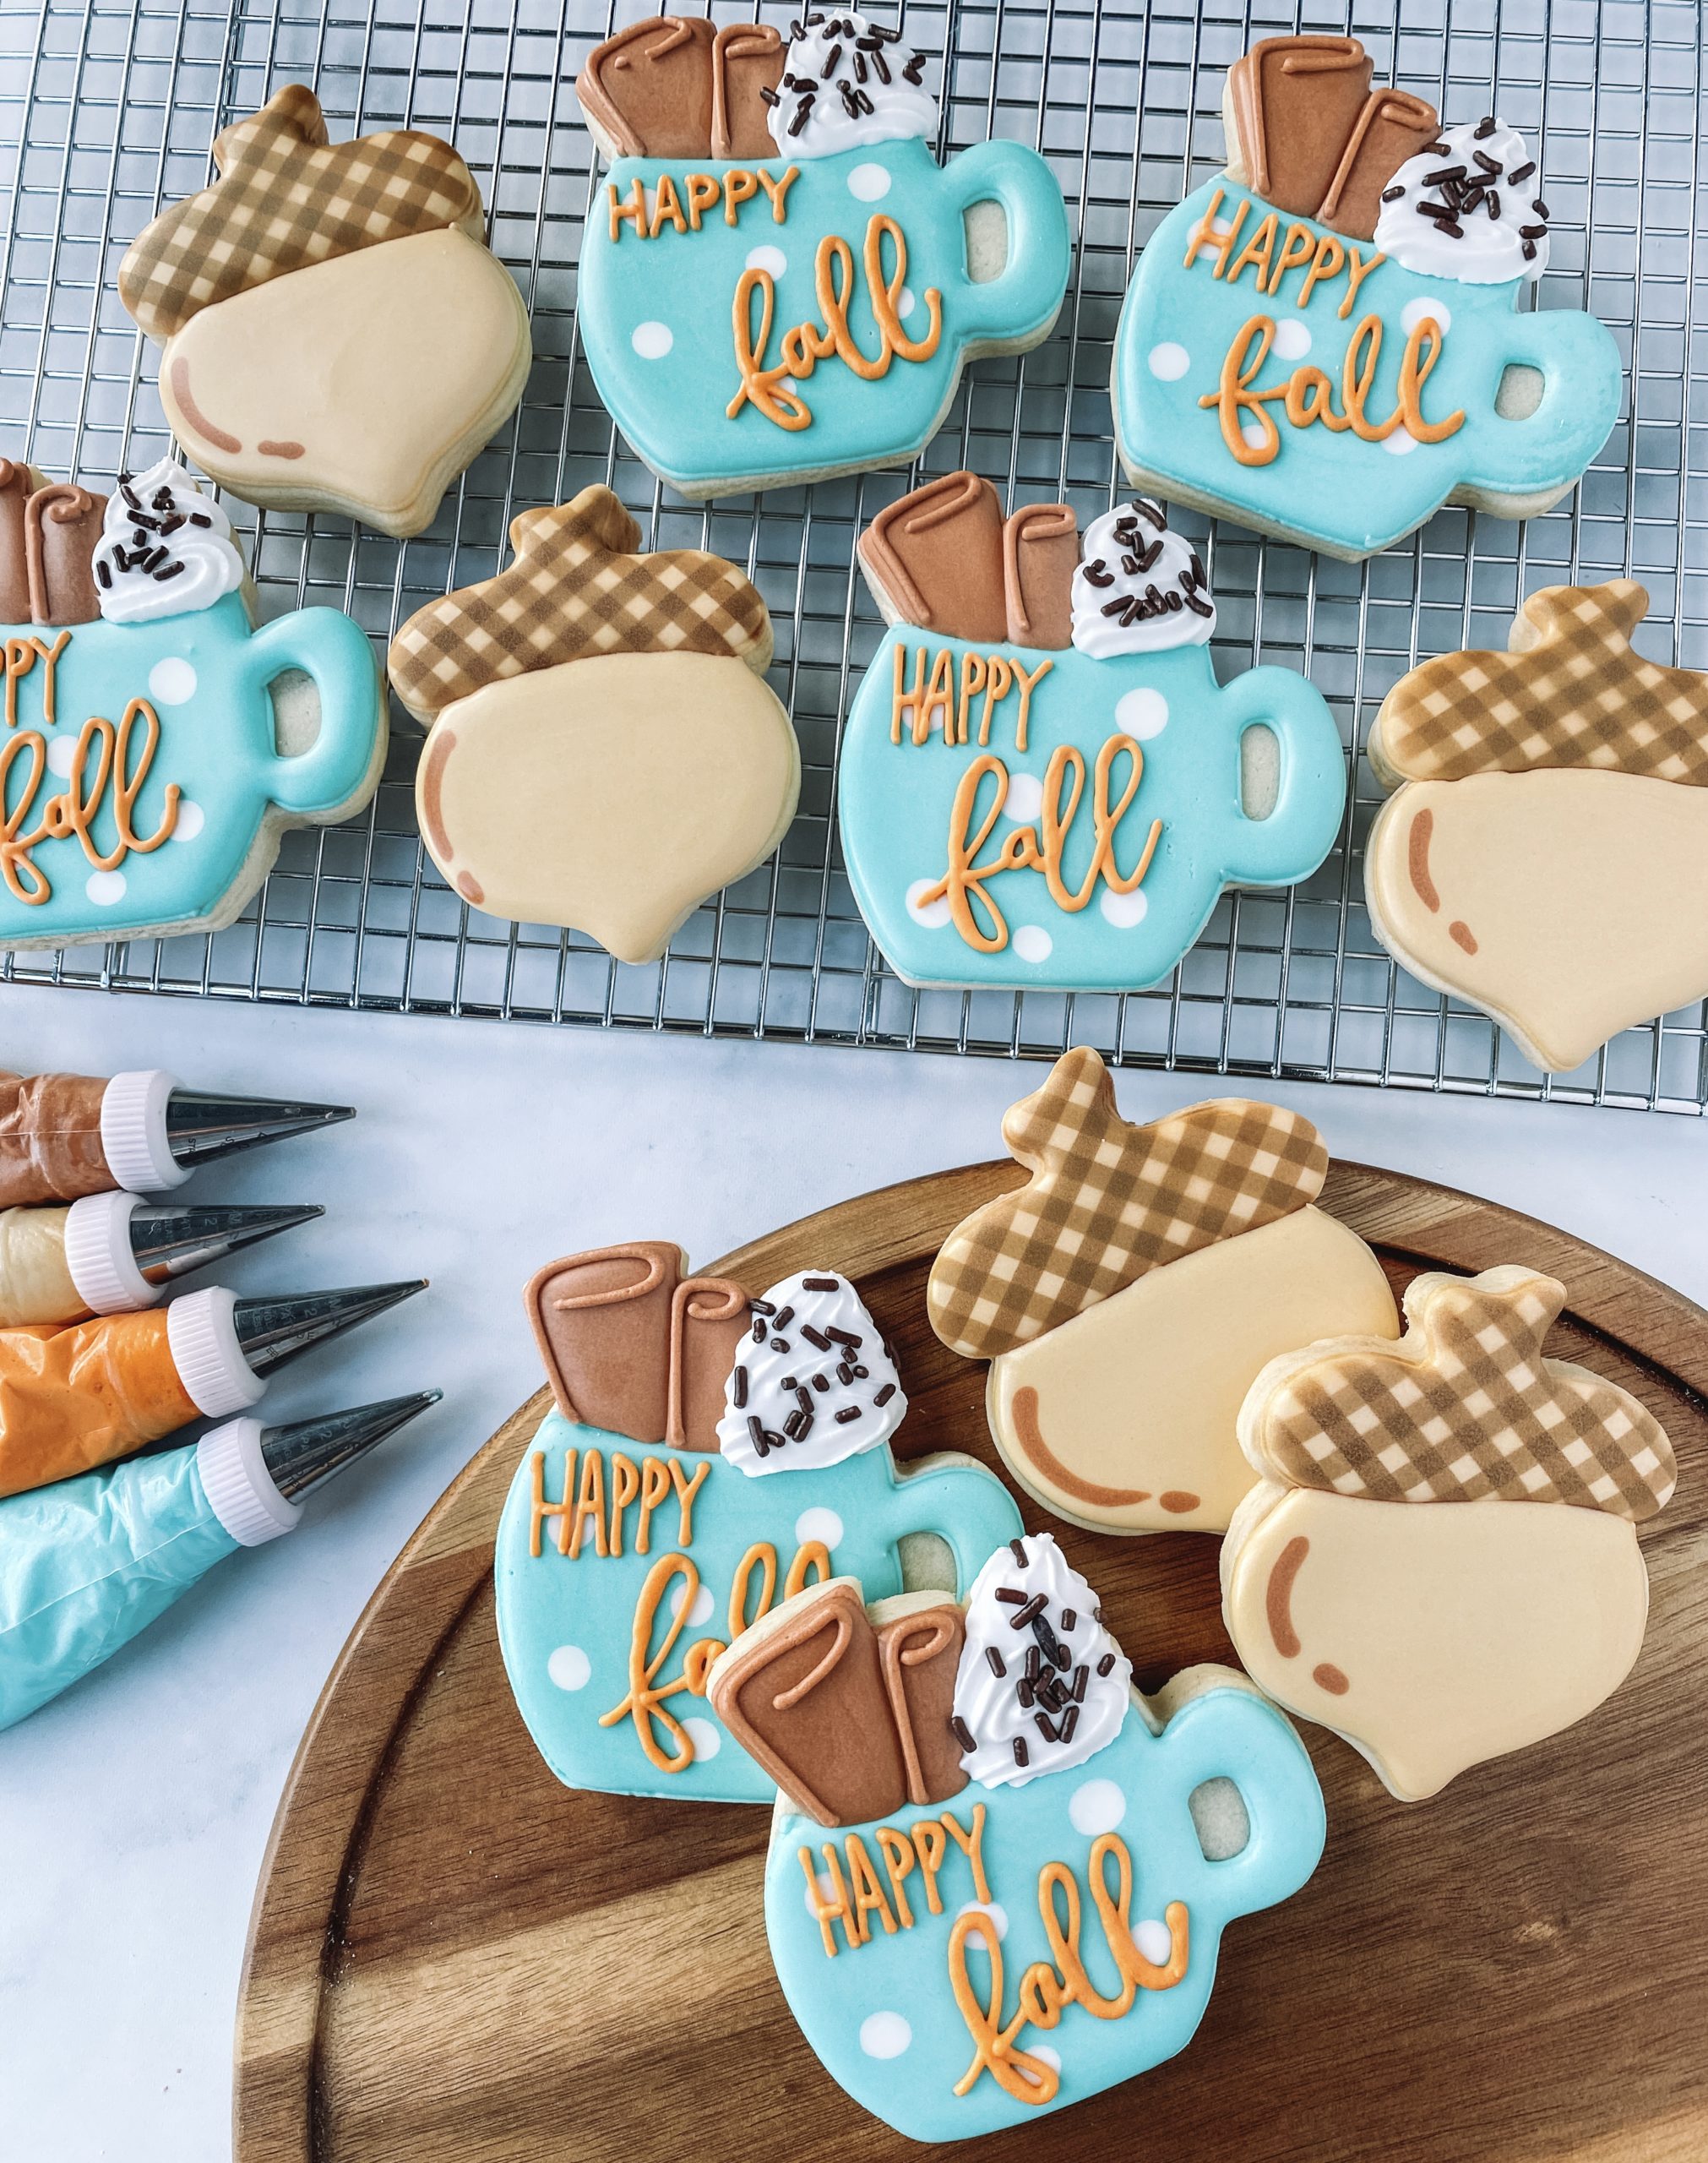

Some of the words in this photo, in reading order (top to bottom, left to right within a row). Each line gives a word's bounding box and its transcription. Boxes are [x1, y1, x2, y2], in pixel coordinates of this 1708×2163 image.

[608, 166, 800, 242] HAPPY
[1183, 188, 1387, 319] HAPPY
[726, 214, 942, 433] fall
[1198, 313, 1466, 467] fall
[0, 630, 73, 728] PY
[890, 642, 1054, 753] HAPPY
[917, 733, 1163, 954] fall
[530, 1447, 711, 1561] HAPPY
[797, 1802, 992, 1959] HAPPY
[947, 1832, 1189, 2106] fall
